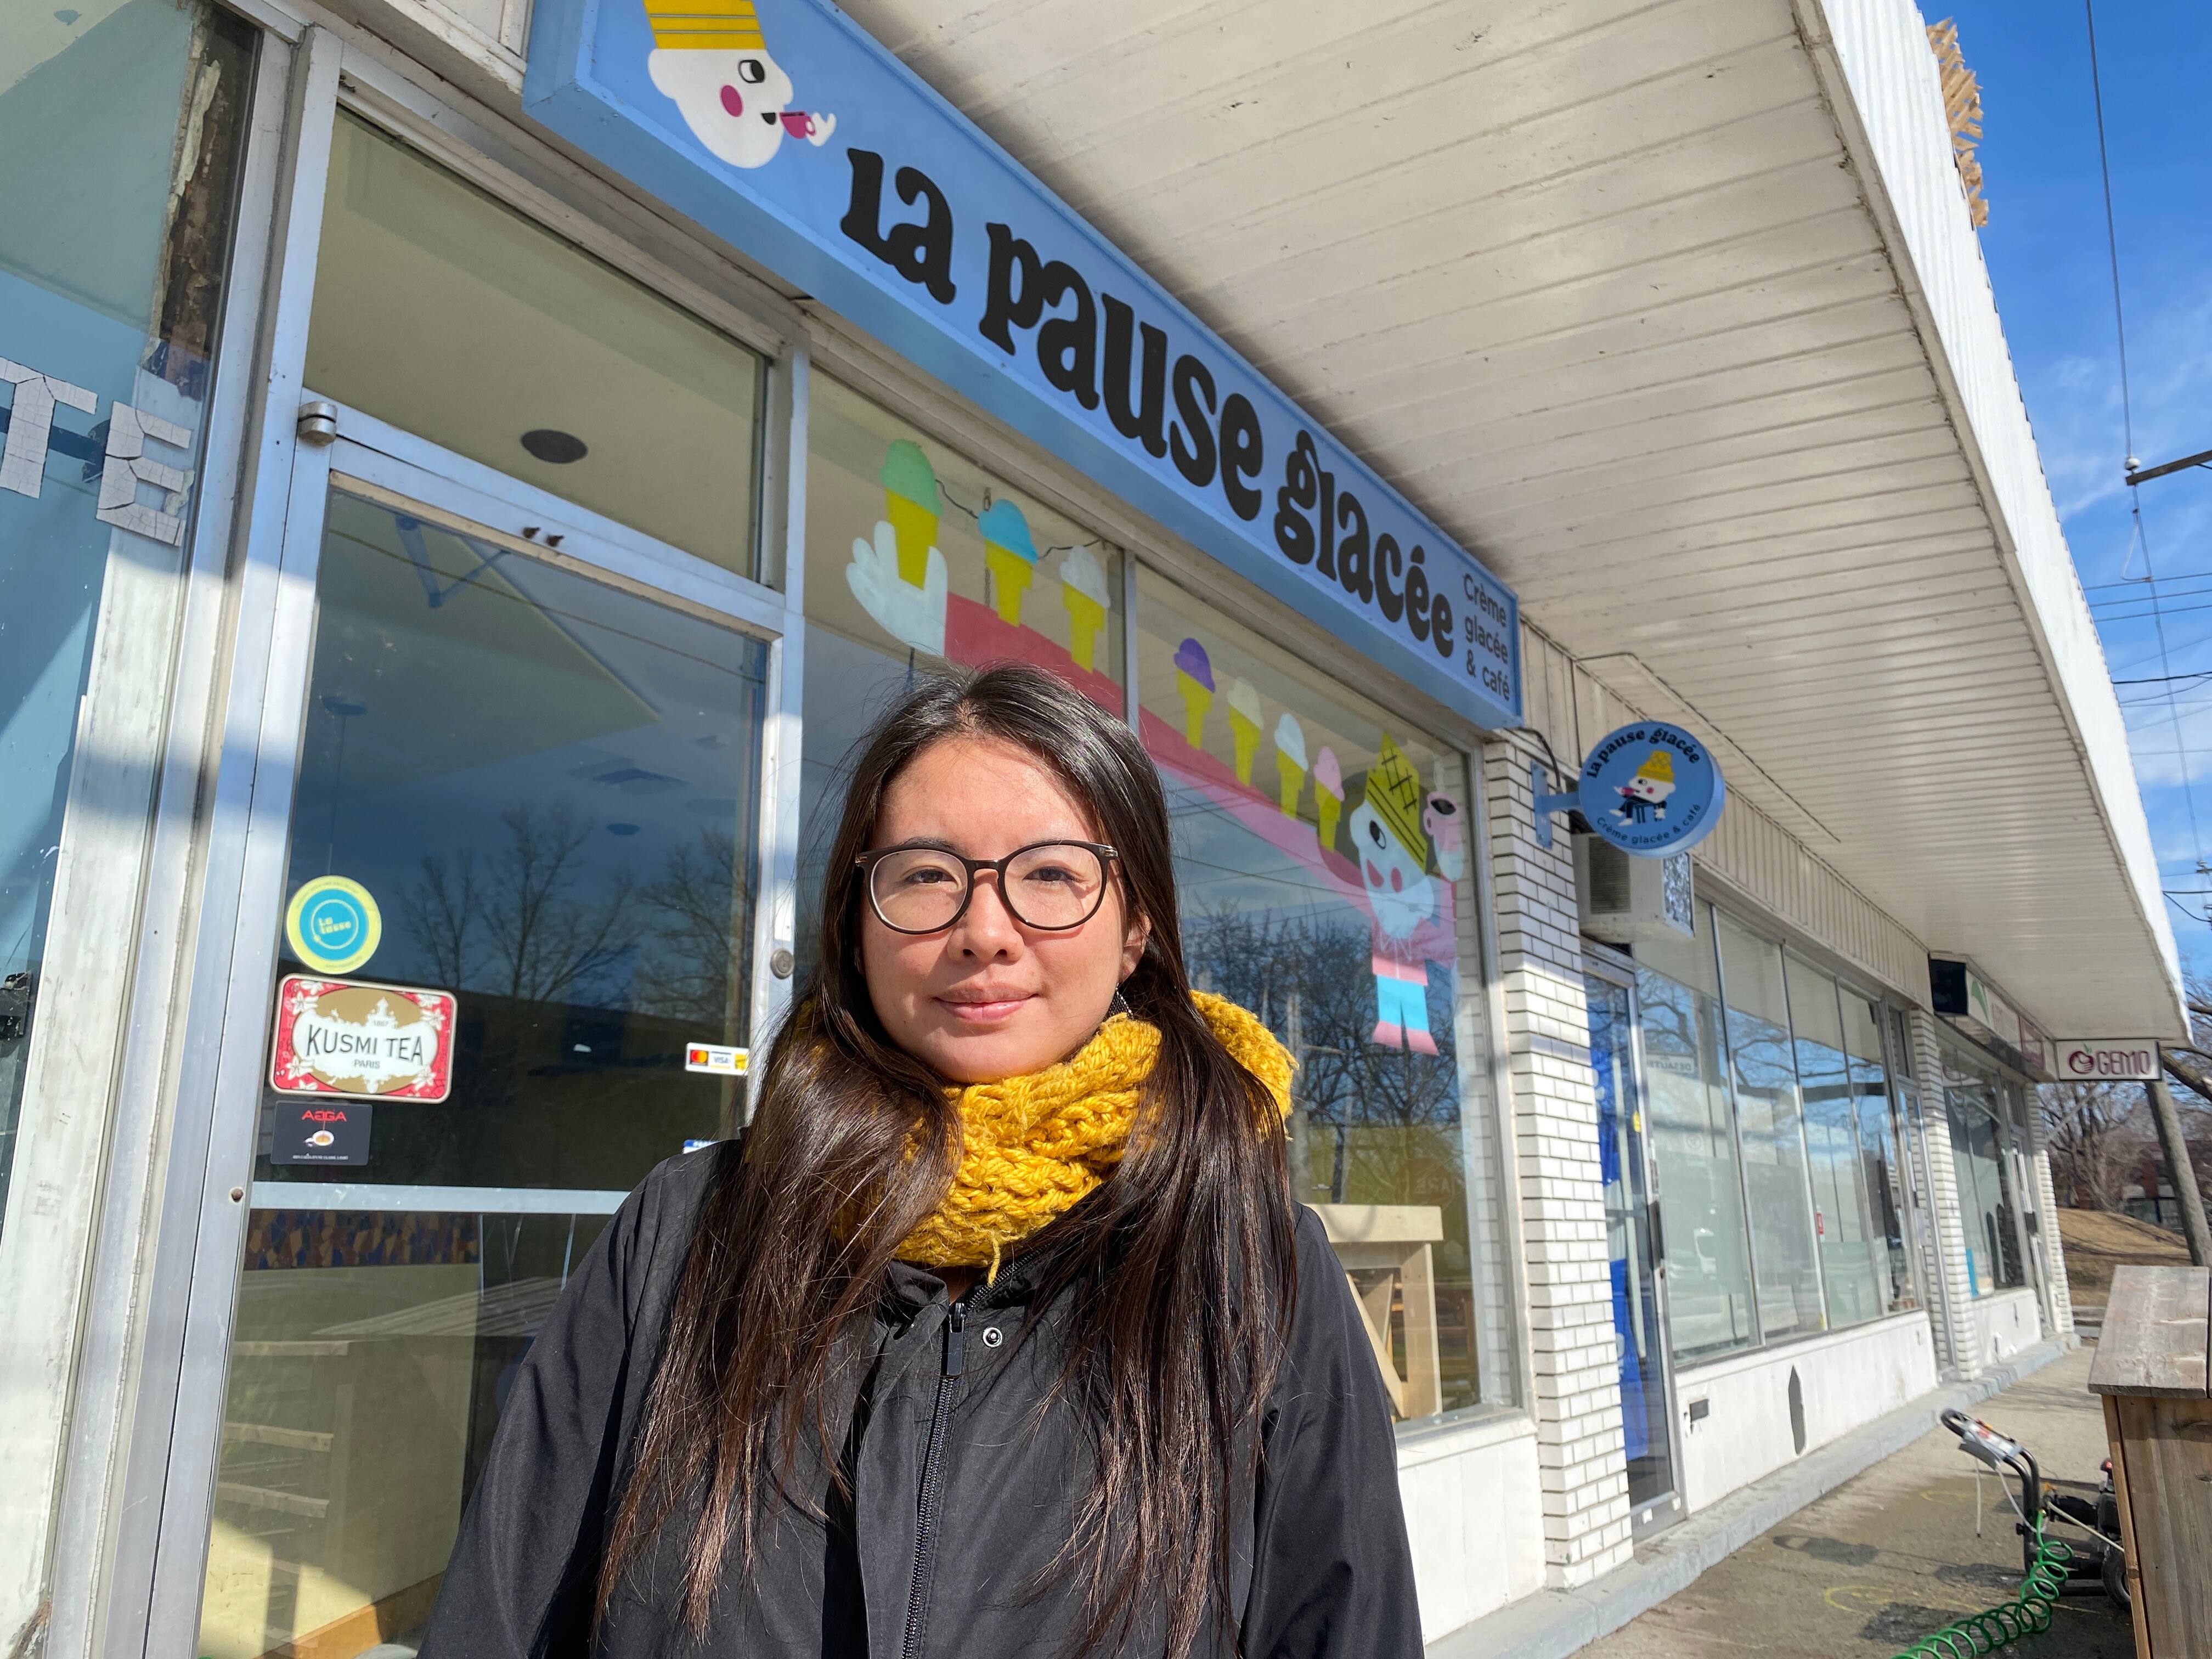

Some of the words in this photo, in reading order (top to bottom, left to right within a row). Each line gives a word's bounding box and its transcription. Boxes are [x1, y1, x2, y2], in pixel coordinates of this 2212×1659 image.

[979, 222, 1263, 522] pause
[1273, 430, 1454, 658] glacée
[1463, 573, 1506, 627] Crème
[1464, 615, 1508, 664] glacée
[1466, 648, 1476, 678] &
[1482, 665, 1510, 701] café
[1598, 730, 1645, 764] pause
[1649, 727, 1700, 764] glacée
[1597, 817, 1628, 841] Crème
[1632, 831, 1670, 845] glacée
[1673, 825, 1681, 834] &
[1683, 803, 1701, 826] café
[306, 1024, 378, 1057] KUSMI
[385, 1035, 424, 1066] TEA
[354, 1059, 381, 1069] PARIS
